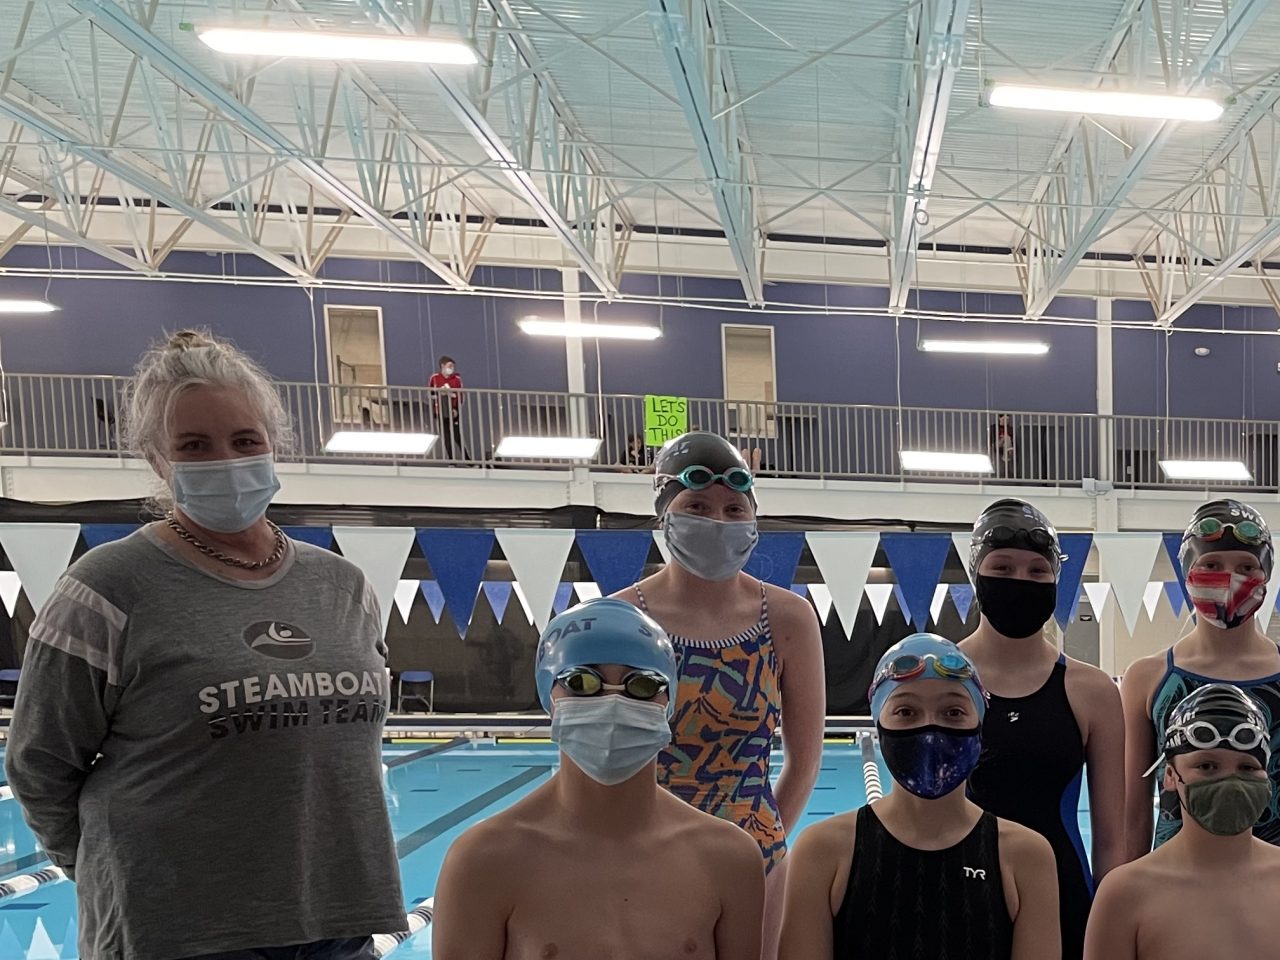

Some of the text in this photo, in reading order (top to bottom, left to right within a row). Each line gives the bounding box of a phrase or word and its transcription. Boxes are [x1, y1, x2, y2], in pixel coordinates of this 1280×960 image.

[652, 398, 686, 413] LETS
[656, 415, 679, 427] DO
[198, 671, 383, 714] STEAMBOAT
[209, 699, 386, 739] SWIM TEAM
[963, 866, 986, 880] TYR
